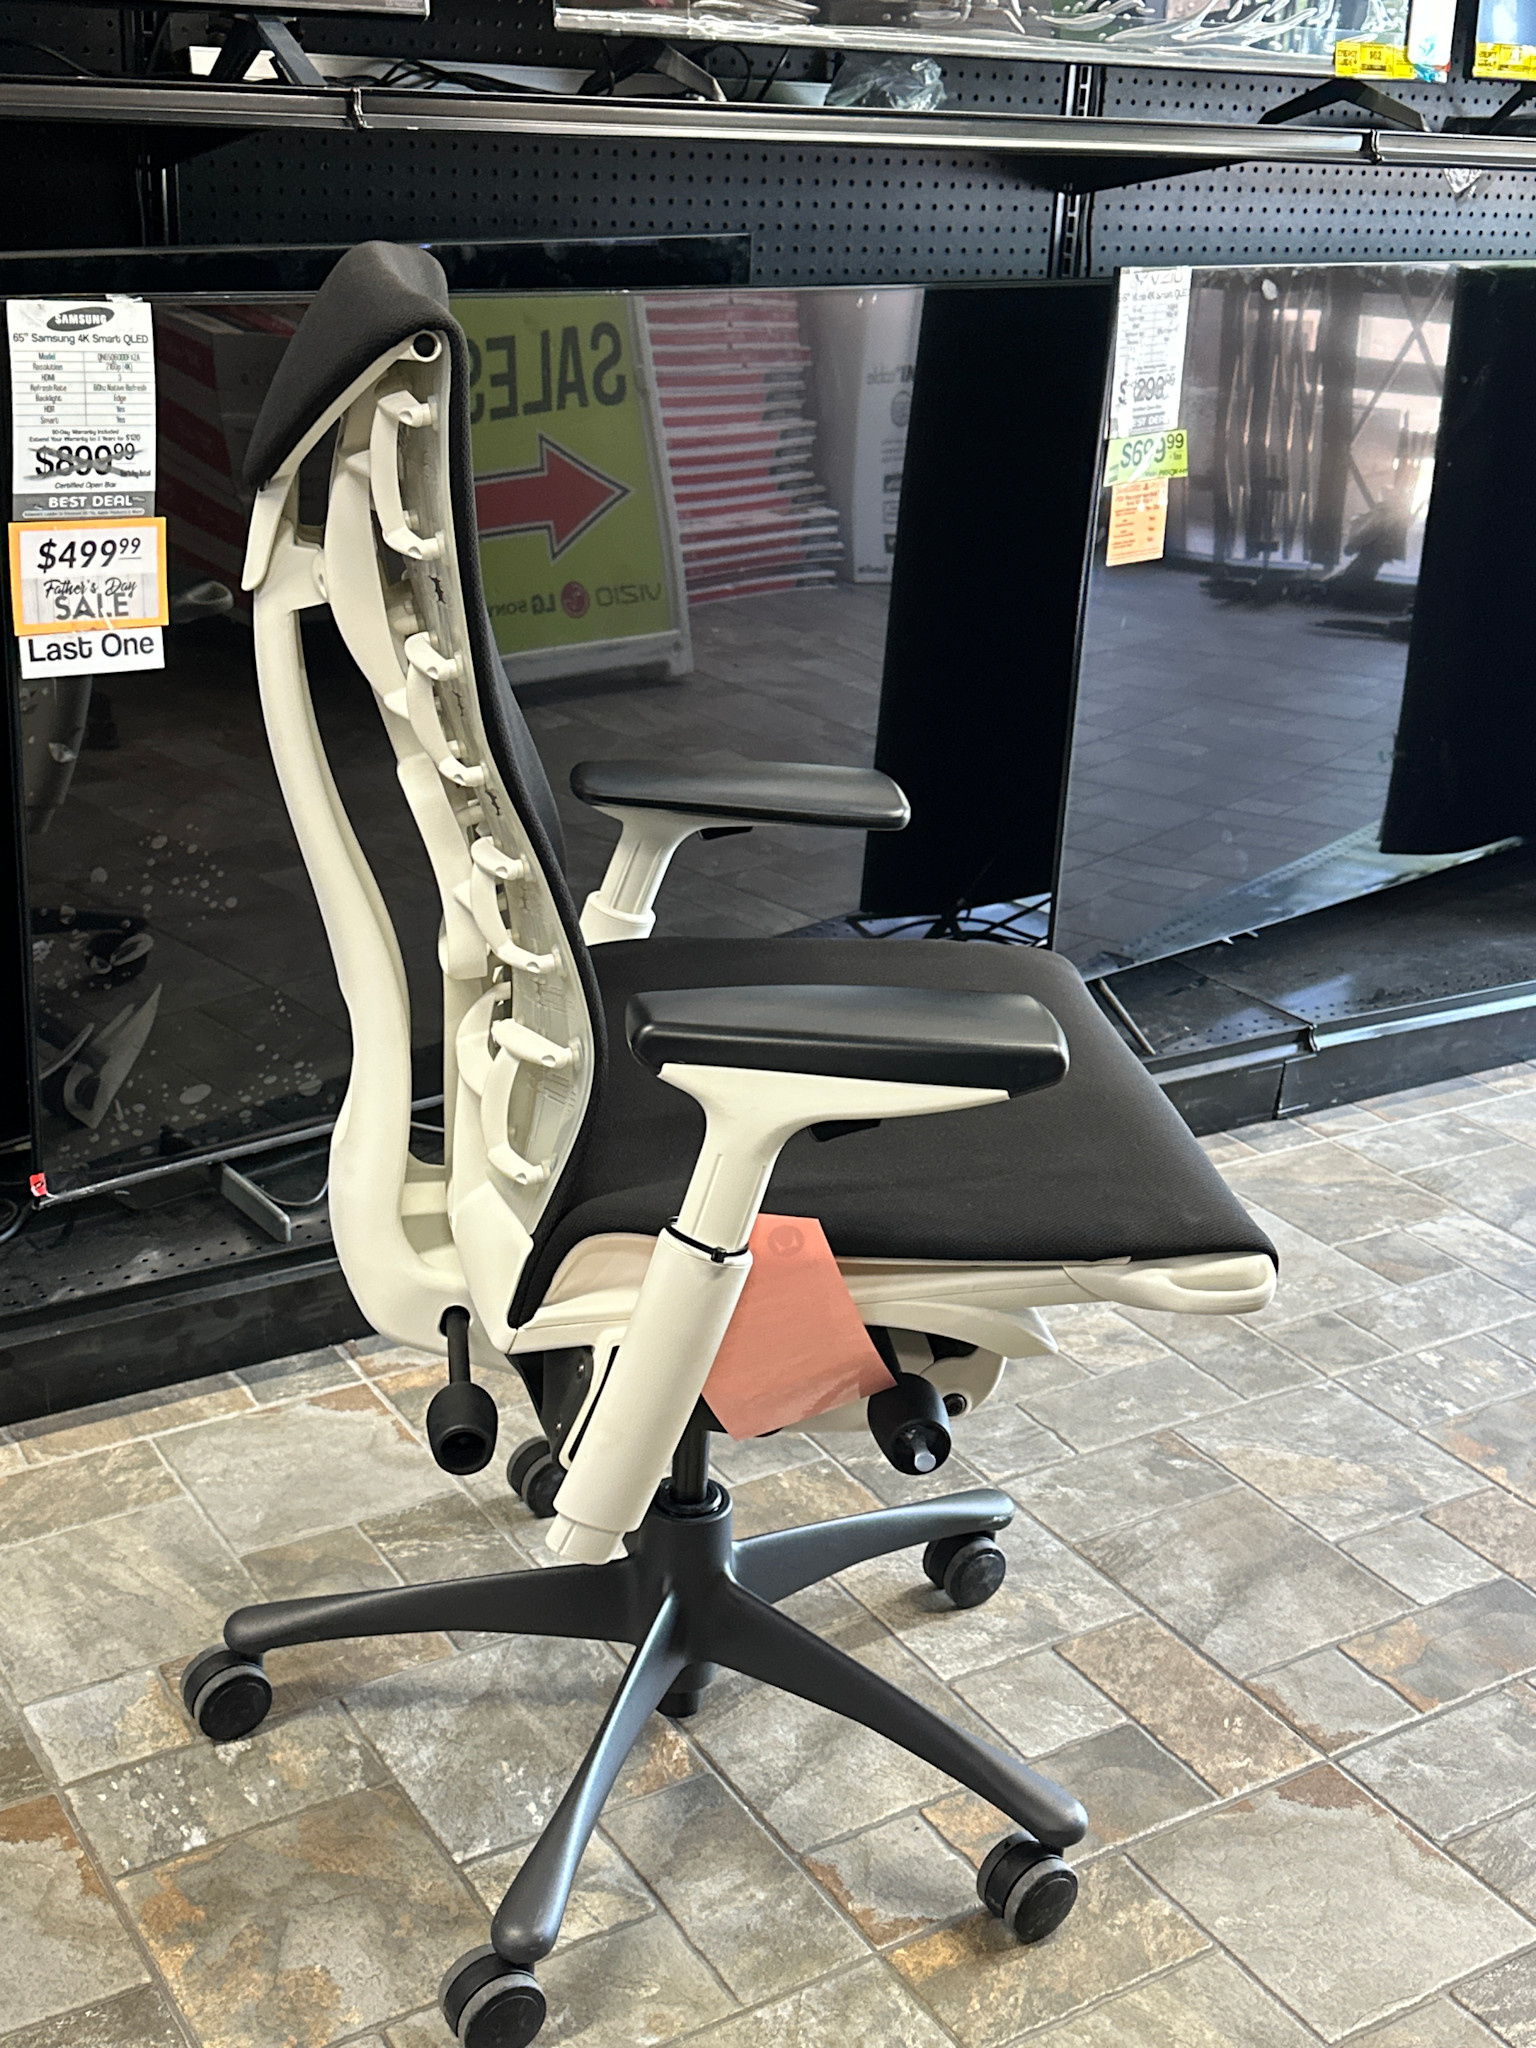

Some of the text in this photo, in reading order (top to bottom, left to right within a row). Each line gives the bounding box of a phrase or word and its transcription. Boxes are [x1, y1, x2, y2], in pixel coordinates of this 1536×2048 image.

[54, 313, 108, 325] SAMSUNG
[12, 332, 149, 346] 65" Samsung 4K Smart QLED
[38, 352, 56, 361] Model
[32, 363, 64, 371] Resolution
[41, 373, 56, 382] HDMI
[30, 383, 68, 392] Refresh Rate
[106, 383, 125, 392] Native
[125, 383, 148, 392] Refresh
[35, 395, 63, 405] Backlight
[113, 394, 127, 405] Edge
[43, 405, 56, 413] HDR
[40, 416, 60, 425] Smart
[86, 481, 104, 489] Open
[48, 494, 133, 508] BEST DEAL
[43, 577, 138, 600] Father's Day
[54, 592, 129, 621] SALE
[28, 632, 155, 662] Last One
